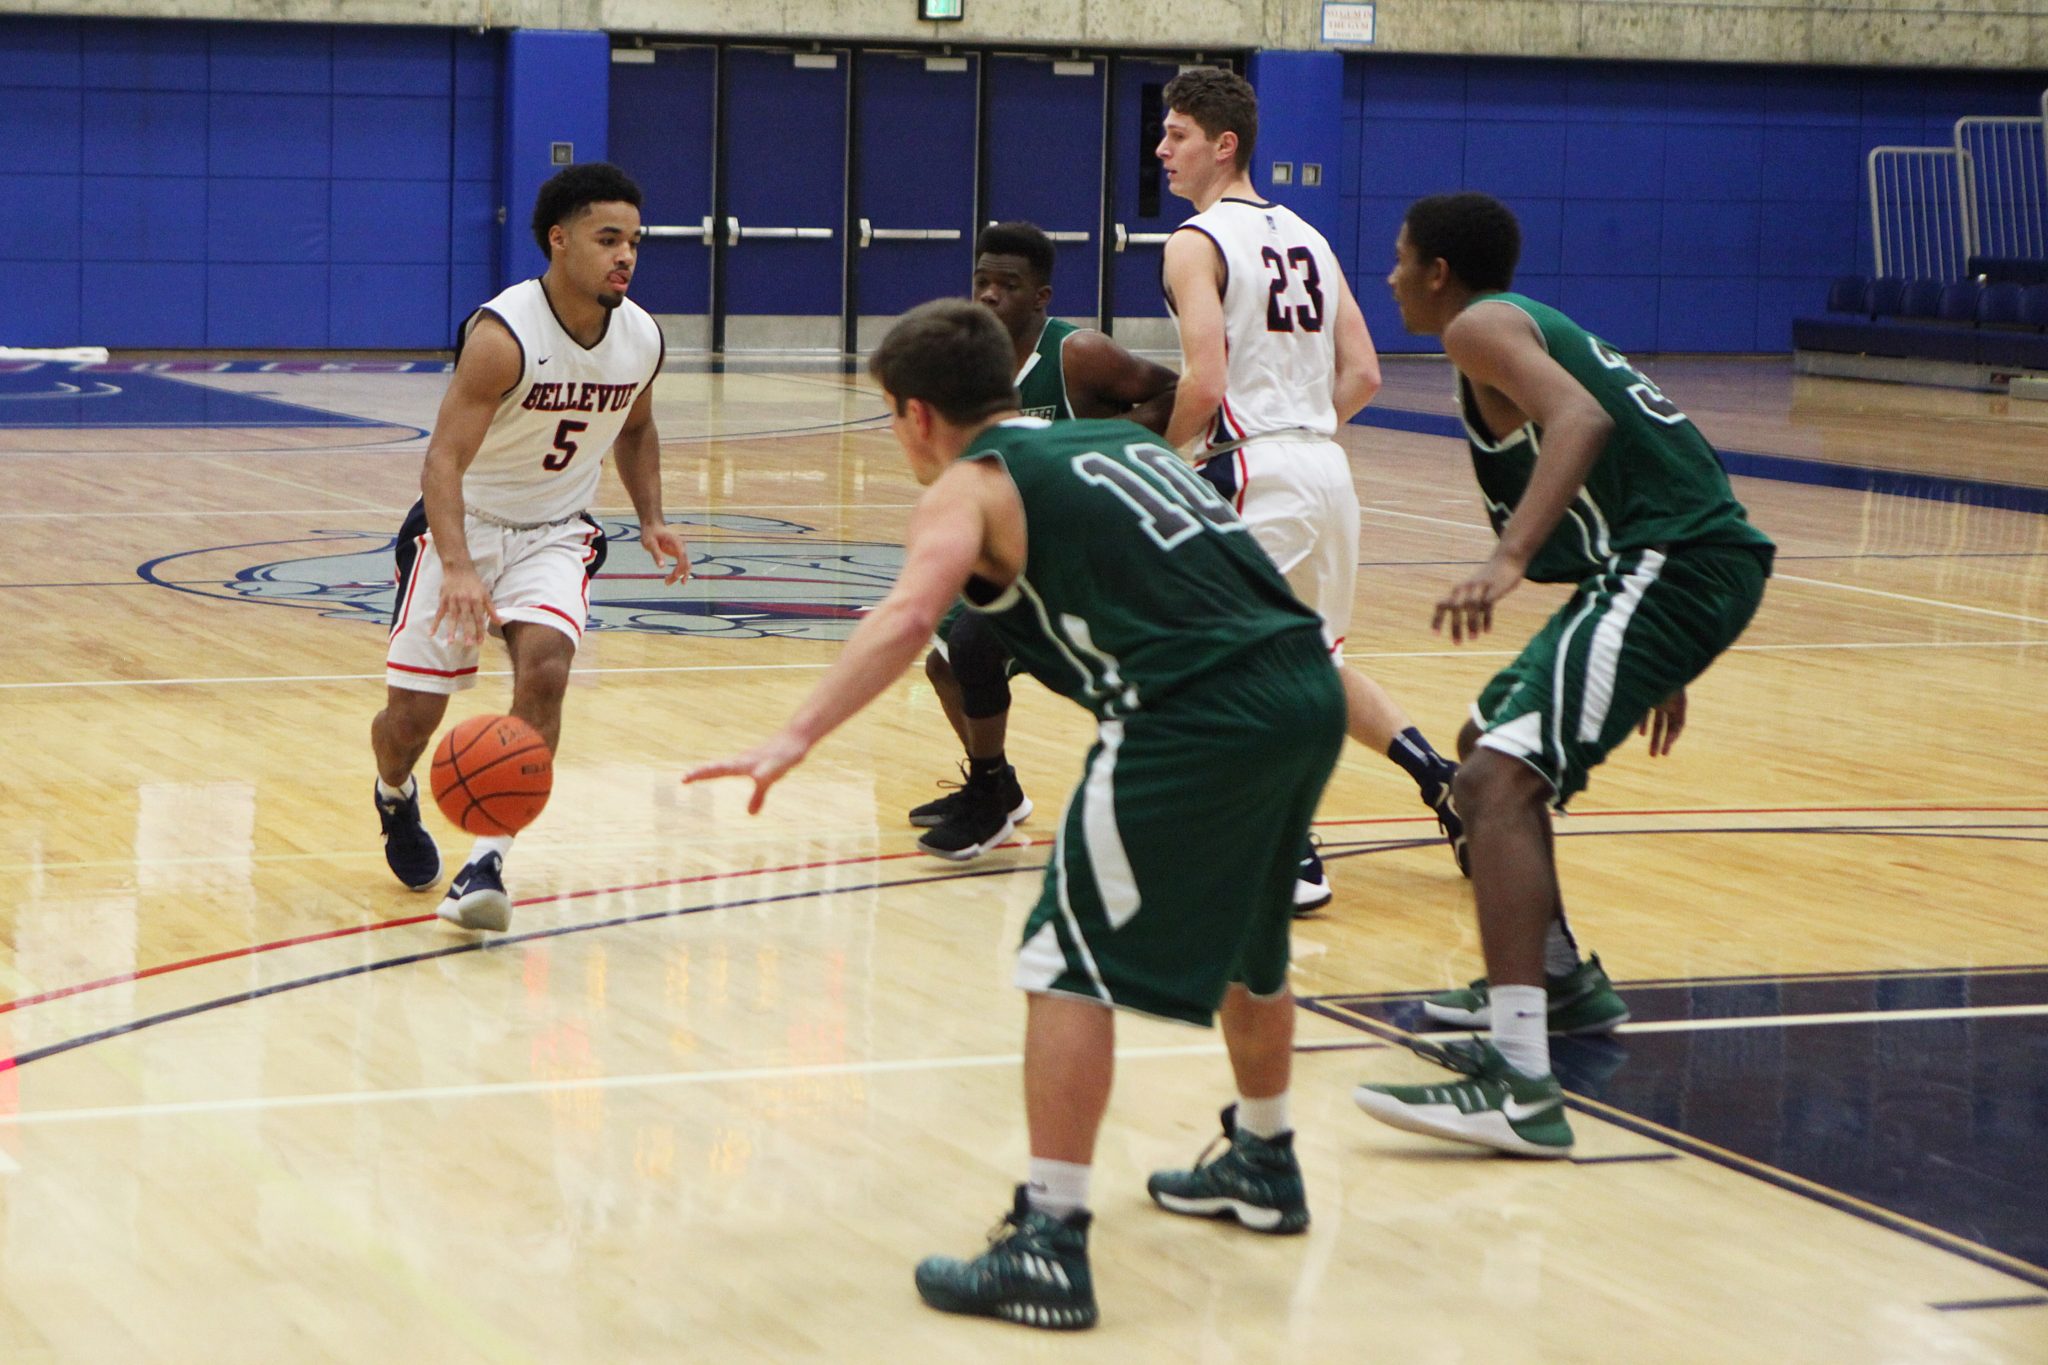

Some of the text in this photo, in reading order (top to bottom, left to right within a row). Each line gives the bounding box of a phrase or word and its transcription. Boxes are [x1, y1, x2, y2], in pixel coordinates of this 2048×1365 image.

[1261, 246, 1324, 332] 23
[521, 382, 639, 412] BELLEVUE
[542, 419, 589, 471] 5
[1072, 443, 1248, 551] 10
